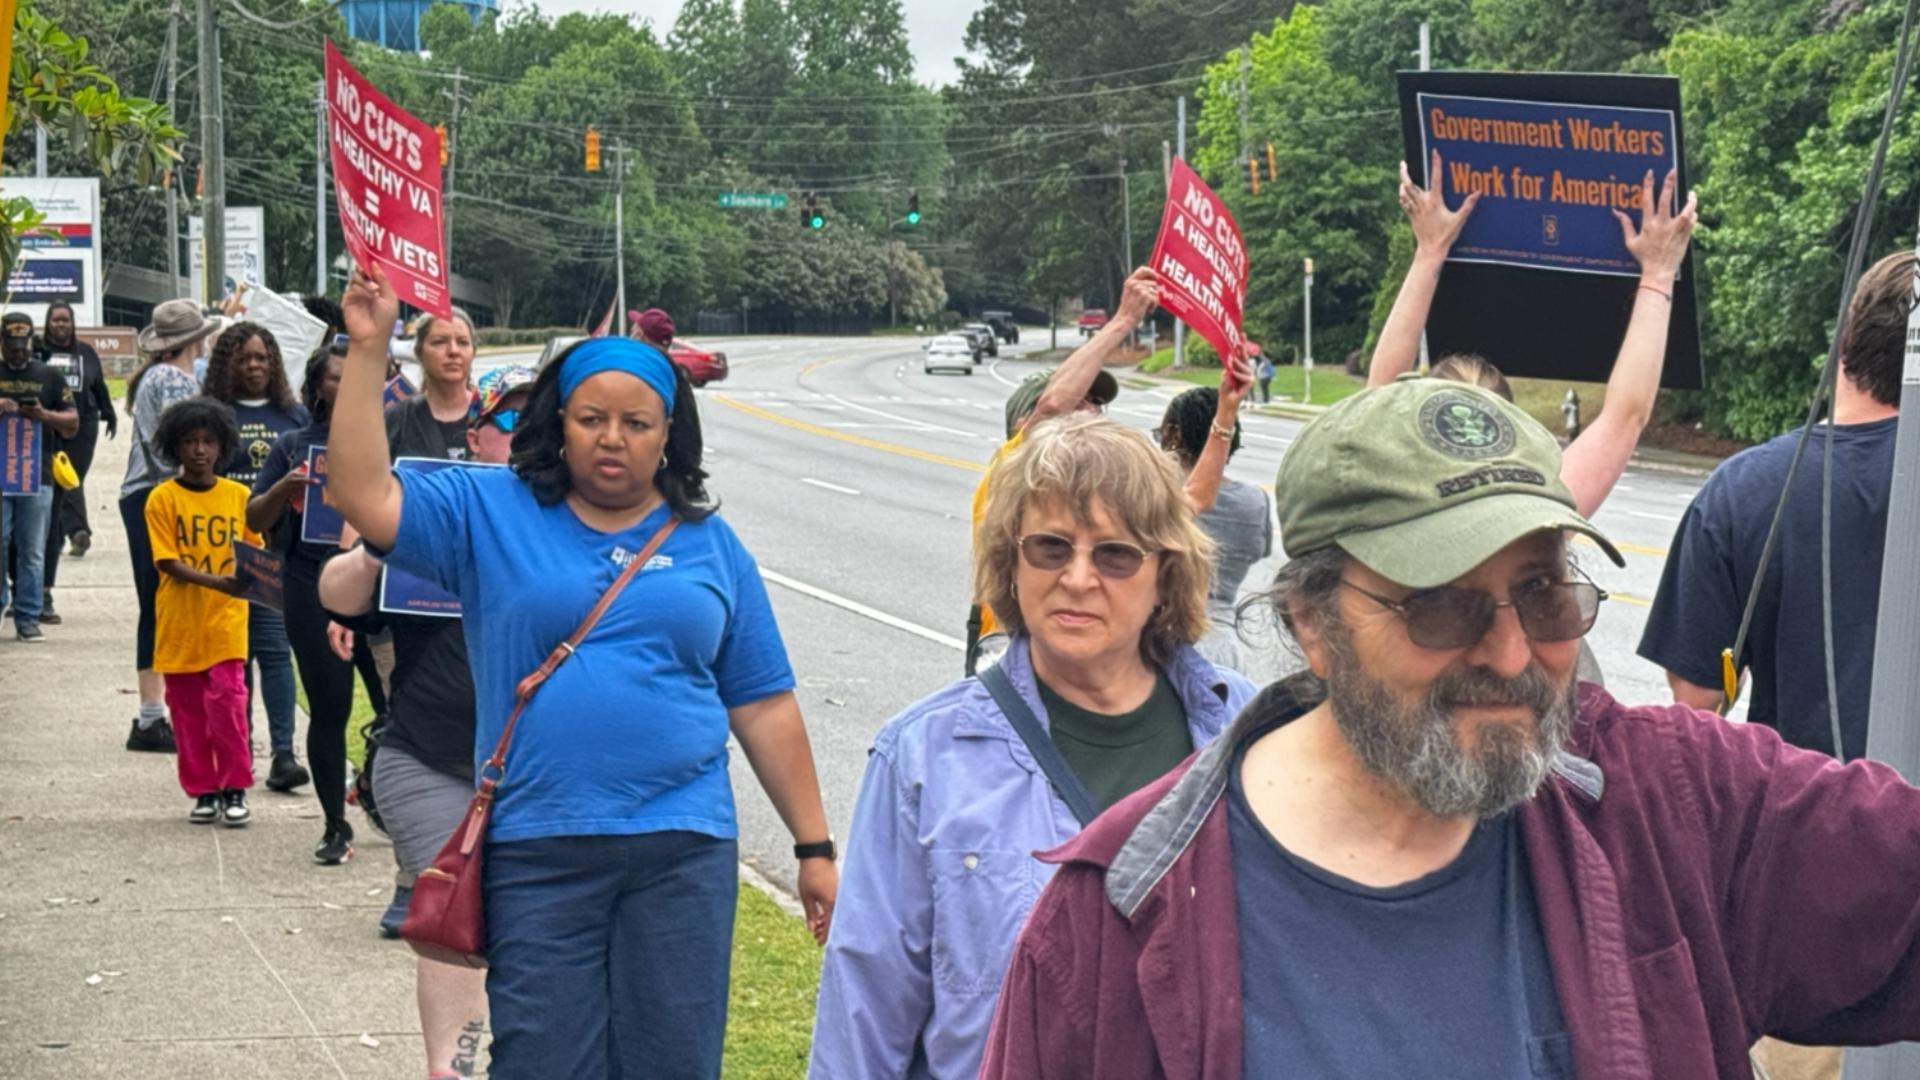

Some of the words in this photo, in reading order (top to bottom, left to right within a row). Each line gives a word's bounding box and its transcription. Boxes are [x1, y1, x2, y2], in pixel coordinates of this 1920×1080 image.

[336, 68, 361, 125] NO
[364, 101, 422, 171] CUTS
[1430, 107, 1563, 148] Government
[1568, 117, 1665, 157] Workers
[335, 119, 343, 150] A
[343, 128, 403, 200] HEALTHY
[408, 182, 433, 219] VA
[1450, 161, 1507, 198] Work
[1512, 167, 1544, 201] for
[1552, 169, 1645, 209] America
[338, 180, 386, 252] HEALTHY
[389, 232, 439, 278] VETS
[1183, 181, 1214, 228] NO
[1173, 214, 1185, 237] A
[1187, 225, 1238, 294] HEALTHY
[1161, 253, 1225, 322] HEALTHY
[1224, 311, 1241, 349] VET
[94, 338, 120, 350] 1670
[241, 423, 266, 431] AFGE
[1436, 467, 1546, 498] RETIRED
